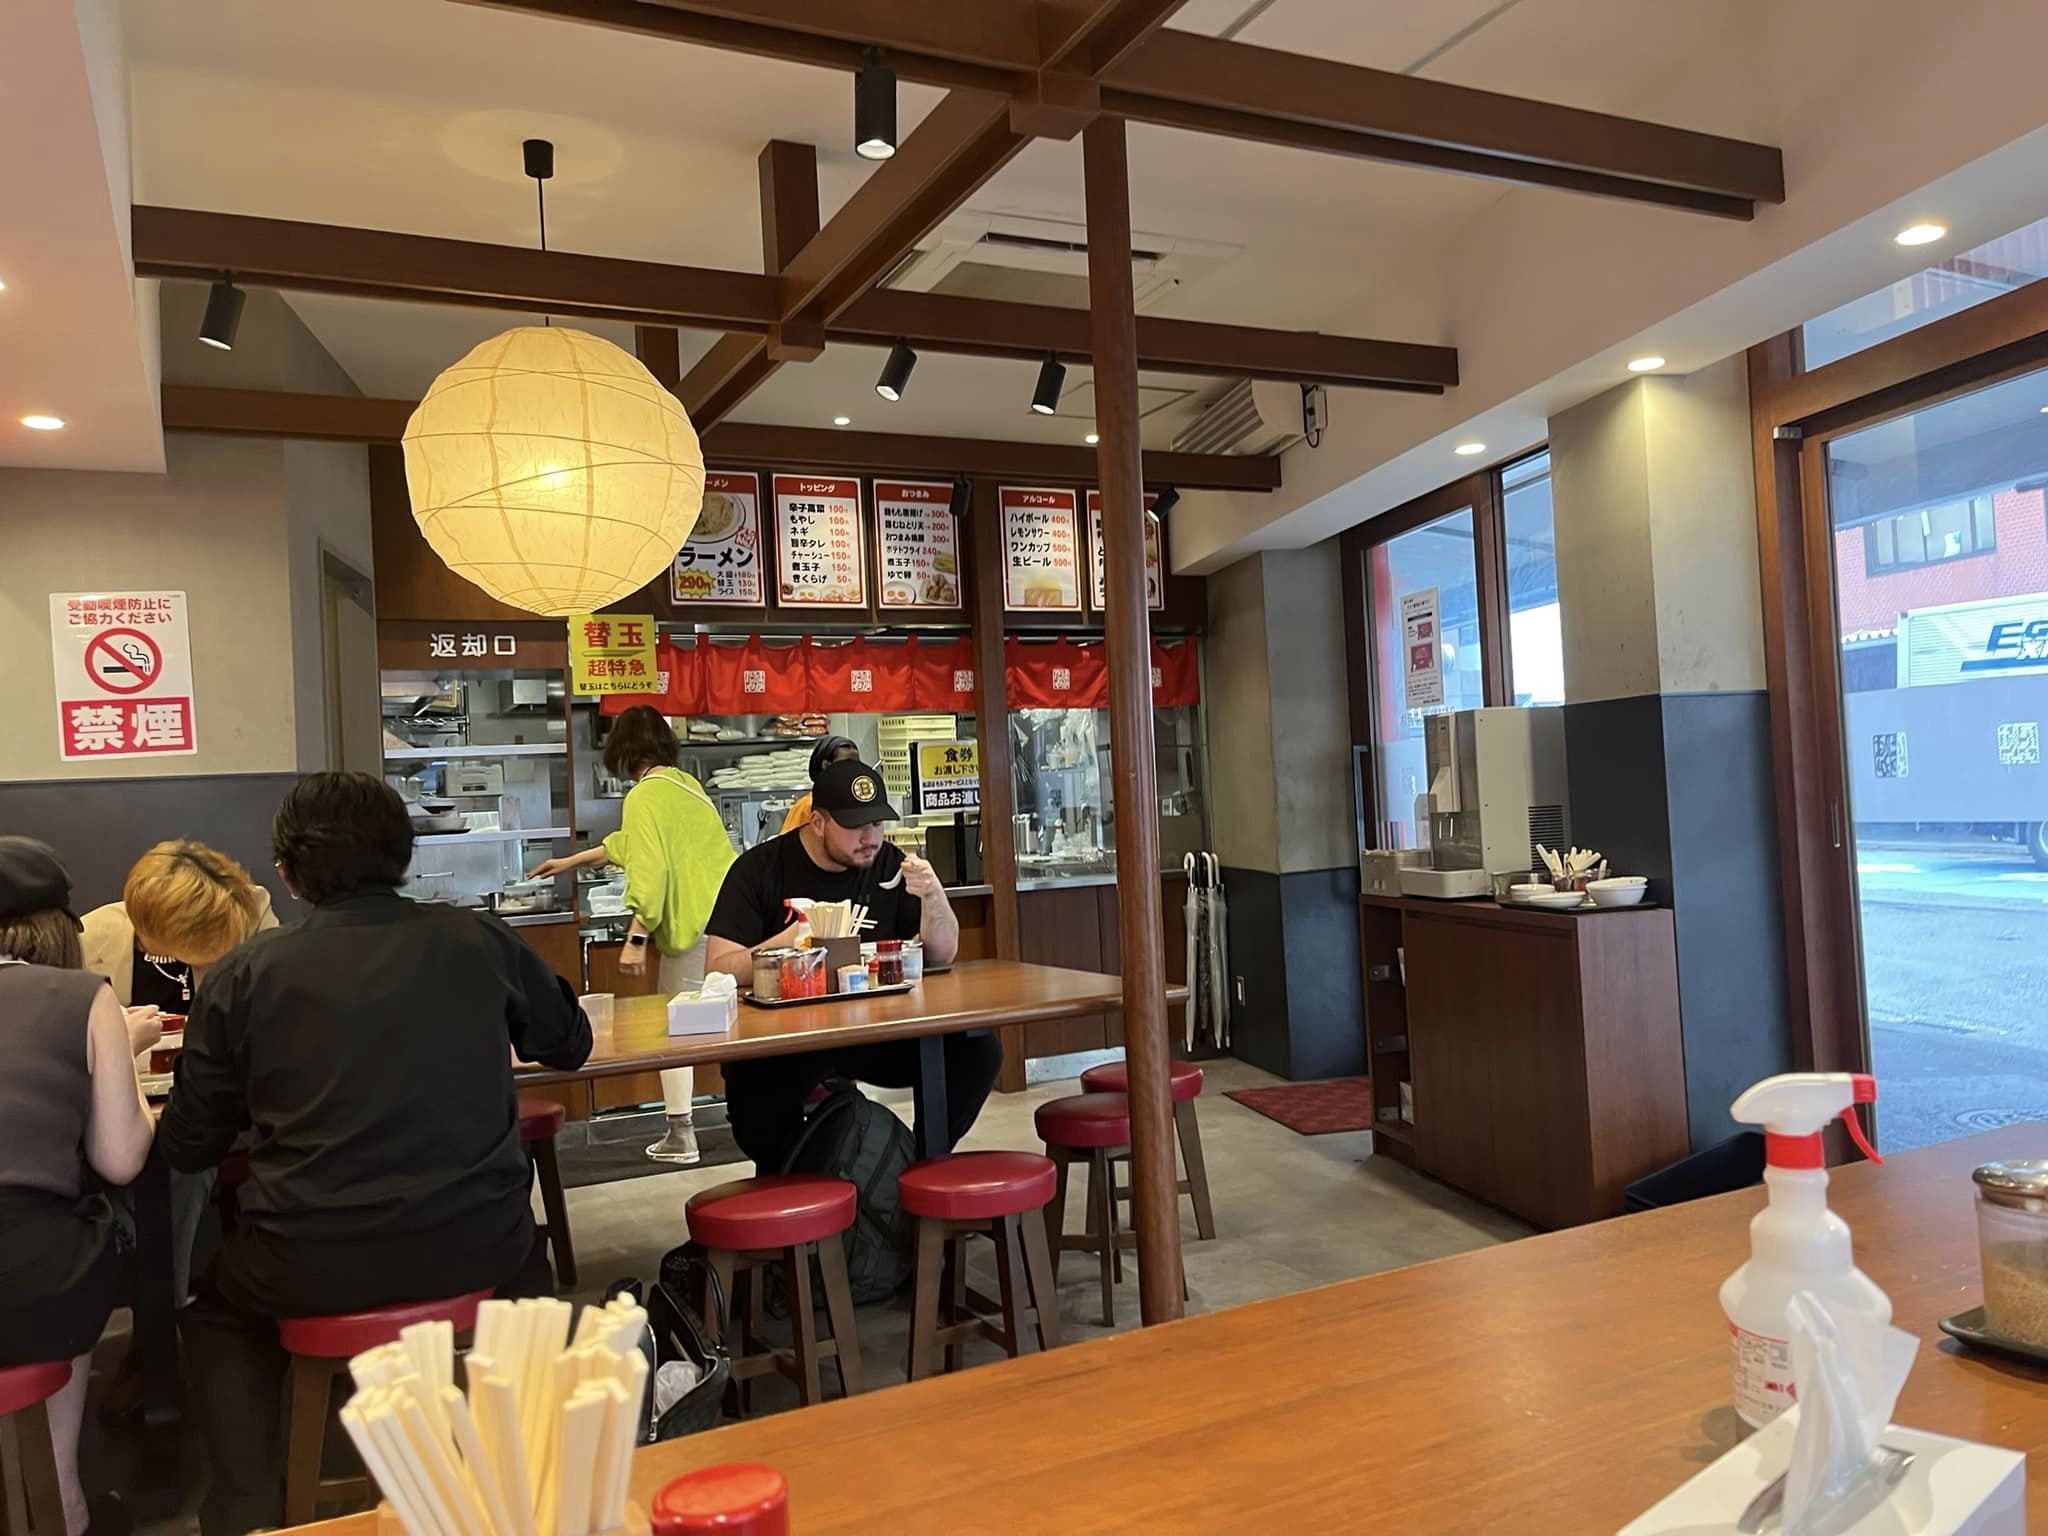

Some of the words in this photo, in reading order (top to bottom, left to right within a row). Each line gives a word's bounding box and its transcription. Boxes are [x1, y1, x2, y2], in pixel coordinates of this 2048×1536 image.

[800, 482, 835, 492] トッピング
[1022, 495, 1056, 504] アルコール
[1010, 513, 1049, 523] ハイボール
[1010, 527, 1050, 538] レモンサワー
[678, 546, 754, 568] ラーメン
[1012, 556, 1052, 567] 生ビール
[67, 598, 171, 611] 受動喫煙防止に
[68, 612, 172, 625] ご協力ください
[583, 620, 646, 648] 替玉
[430, 633, 517, 657] 返却口
[587, 658, 647, 677] 超特急
[71, 704, 185, 751] 禁煙
[944, 747, 973, 763] 食券
